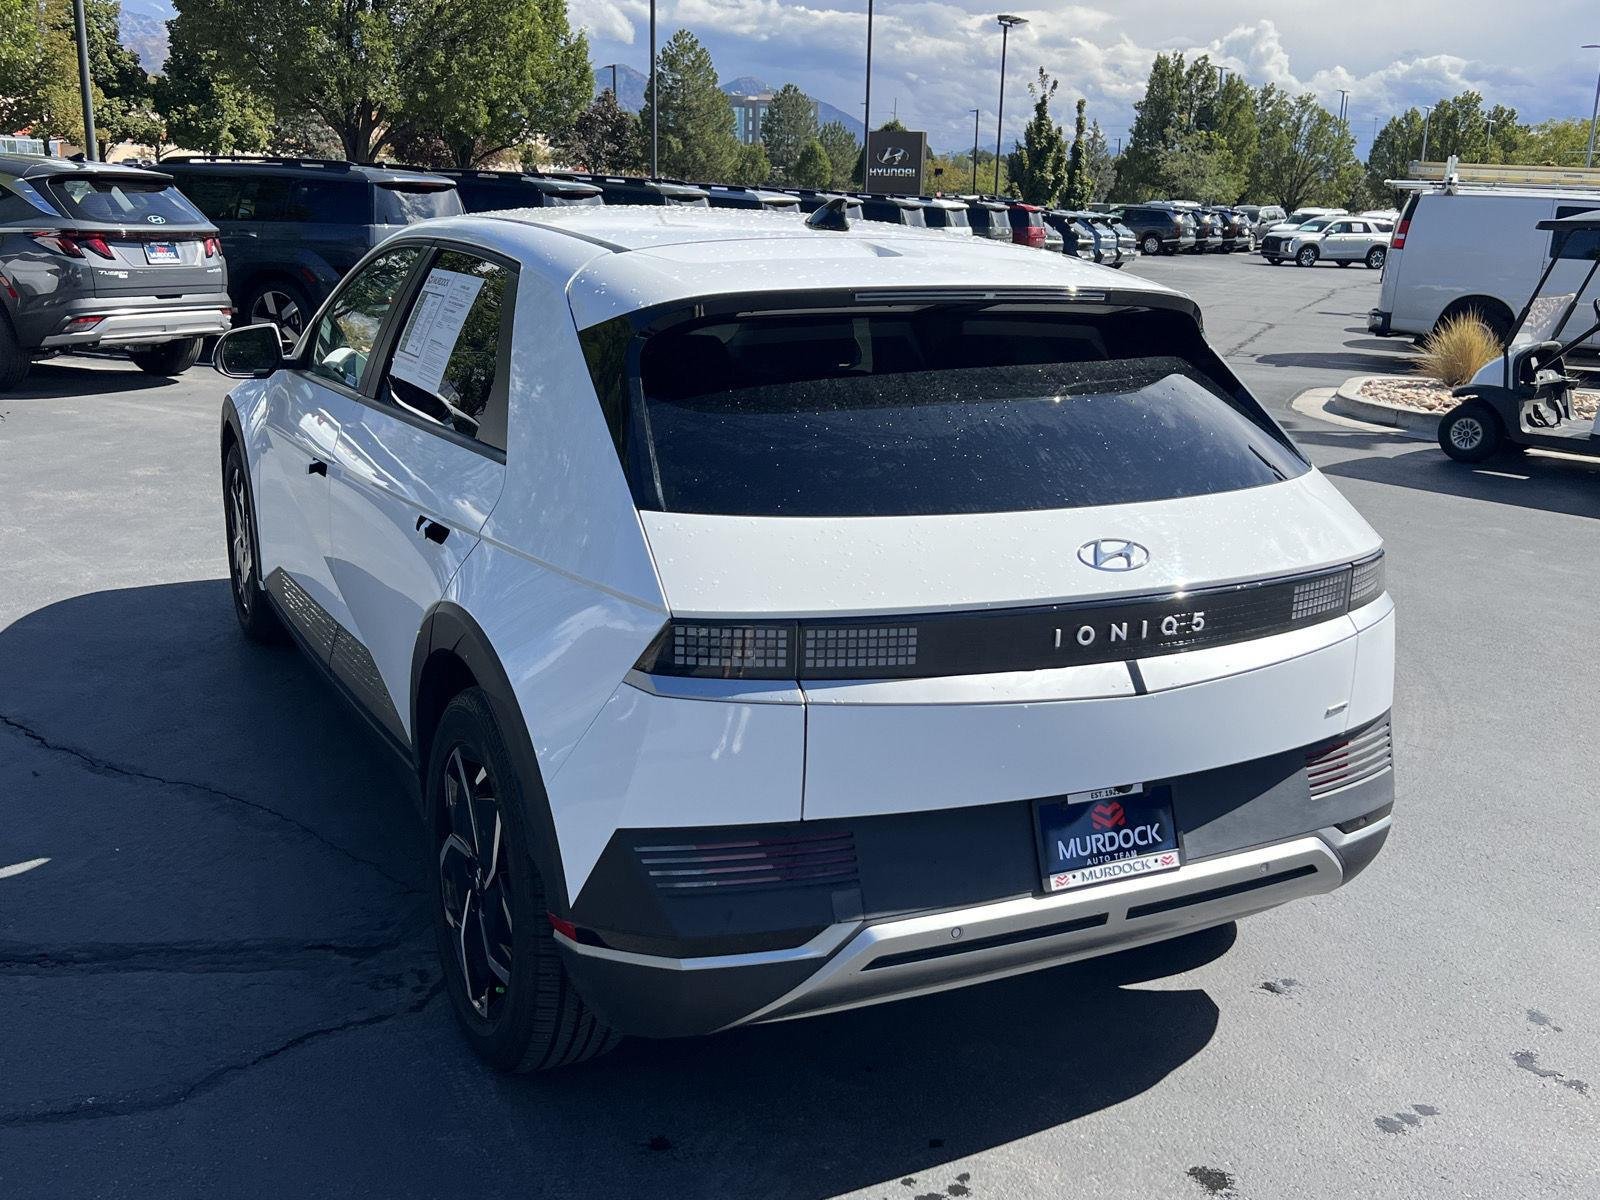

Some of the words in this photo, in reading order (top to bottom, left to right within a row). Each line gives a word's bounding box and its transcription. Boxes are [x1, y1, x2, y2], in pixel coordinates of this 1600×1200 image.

[869, 167, 916, 177] HYUNDAI
[1054, 615, 1178, 648] IONIQ
[1190, 611, 1205, 632] 5
[1057, 822, 1163, 861] MURDOCK
[1086, 855, 1111, 866] AUTO
[1114, 849, 1138, 861] TEAM
[1080, 858, 1152, 882] MURDOCK
